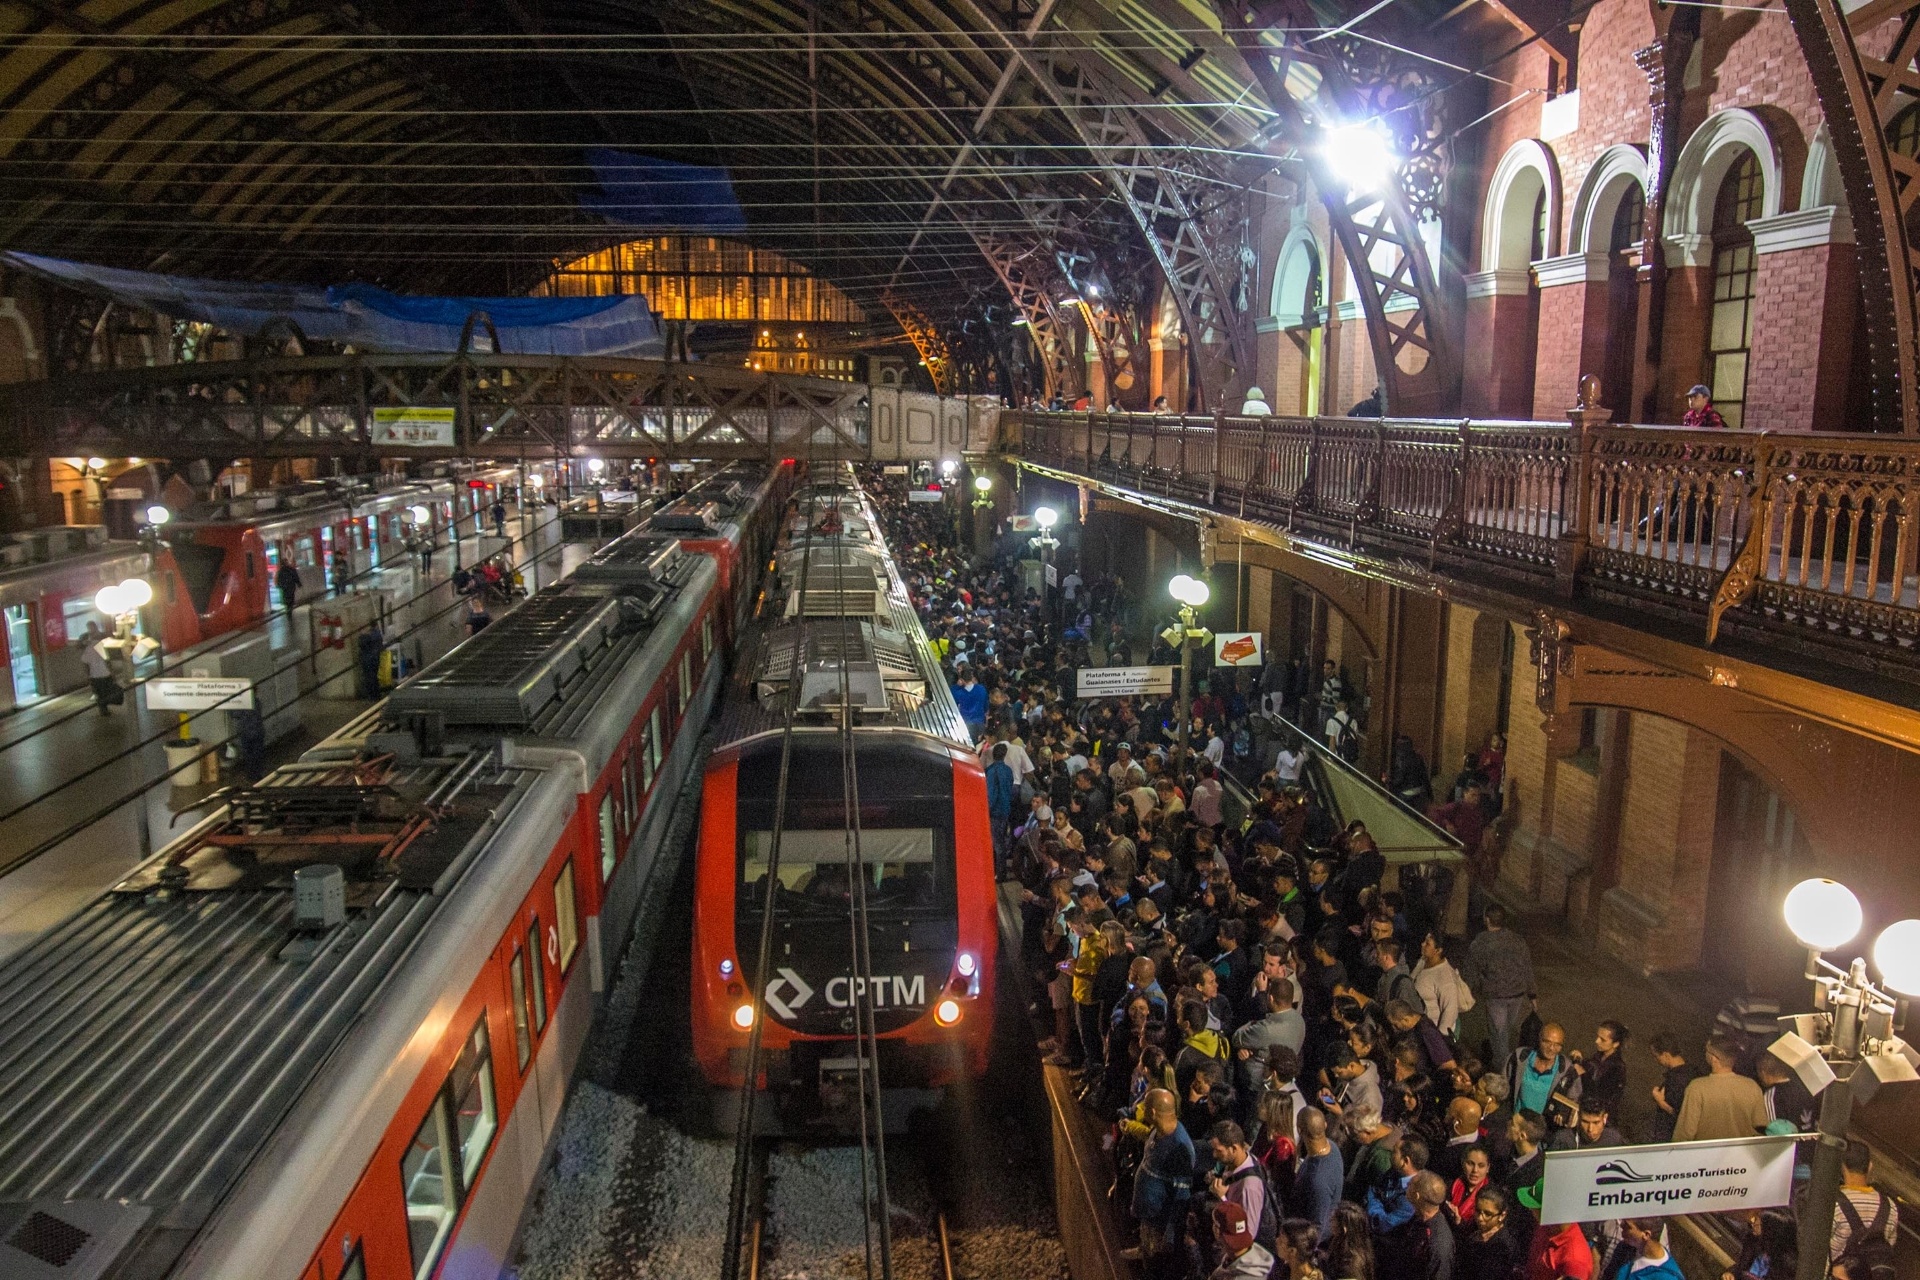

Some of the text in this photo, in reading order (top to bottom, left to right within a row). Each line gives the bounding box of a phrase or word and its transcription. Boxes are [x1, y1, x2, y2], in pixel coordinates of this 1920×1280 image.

[1085, 671, 1121, 679] Plataforma
[1085, 678, 1121, 686] Guaianases
[825, 975, 925, 1007] CPTM
[1588, 1186, 1748, 1207] Embarque Boarding
